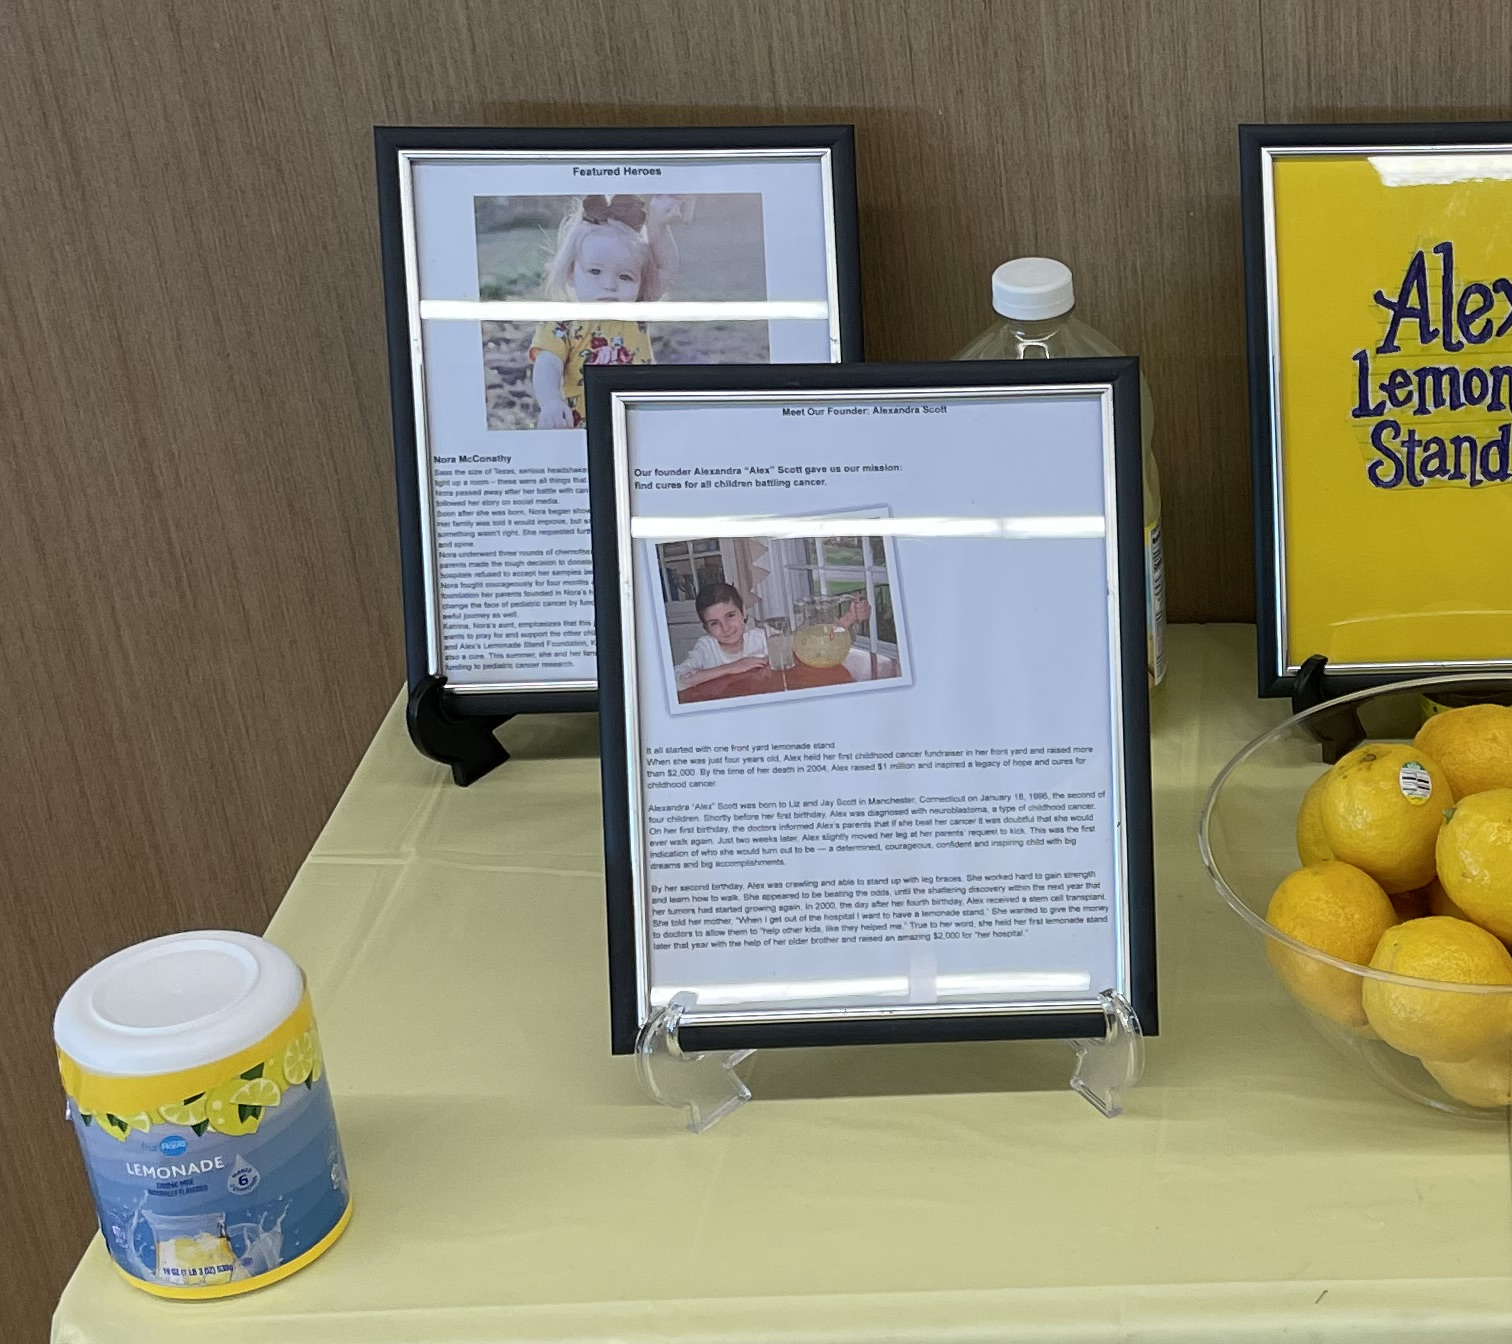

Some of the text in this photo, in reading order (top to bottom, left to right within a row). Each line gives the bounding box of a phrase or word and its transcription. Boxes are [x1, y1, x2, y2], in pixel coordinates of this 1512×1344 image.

[573, 166, 661, 176] Featured Heroes
[782, 406, 805, 416] Meet
[807, 406, 824, 415] Our
[872, 405, 920, 414] Alexandra
[922, 404, 947, 413] Scott
[1367, 419, 1511, 488] Stand
[634, 468, 651, 476] Our
[654, 467, 690, 476] founder
[694, 467, 741, 475] Alexandra
[744, 466, 774, 474] "Alex"
[777, 465, 802, 473] Scott
[805, 466, 826, 474] gave
[634, 481, 652, 489] find
[684, 480, 697, 488] for
[700, 480, 711, 488] all
[714, 479, 752, 487] children
[755, 479, 790, 488] battling
[751, 744, 769, 752] yard
[771, 742, 810, 750] lemonade
[126, 1156, 224, 1179] LEMONADE
[238, 1175, 248, 1186] 6
